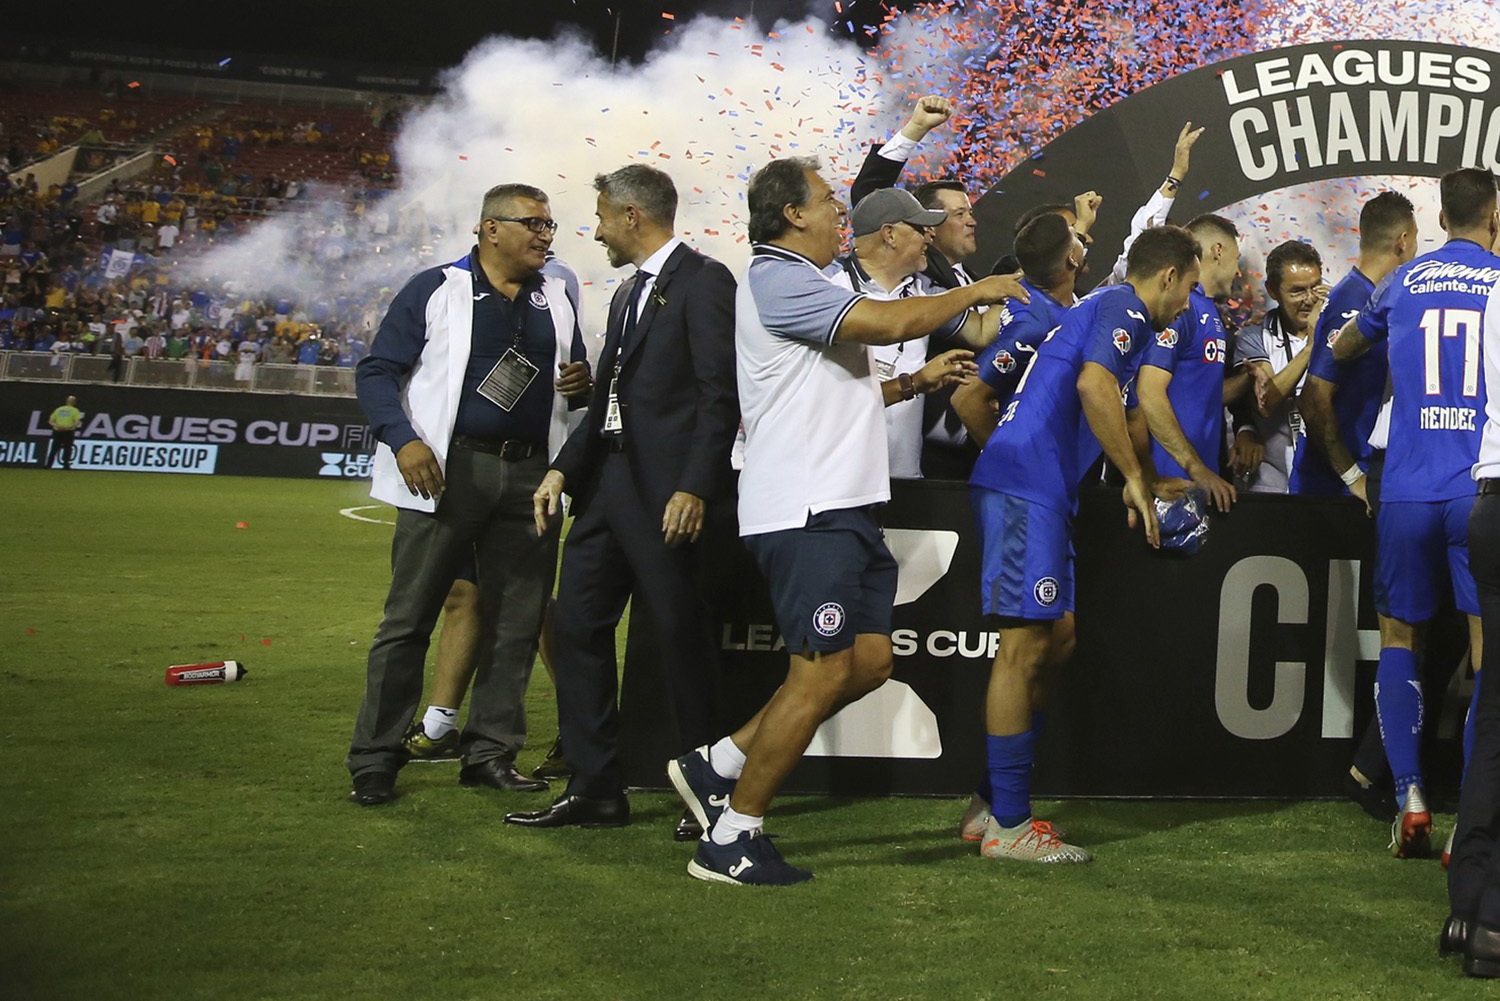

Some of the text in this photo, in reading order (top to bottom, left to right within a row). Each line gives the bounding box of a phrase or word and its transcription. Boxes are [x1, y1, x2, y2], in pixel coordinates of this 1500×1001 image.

[1222, 50, 1491, 104] LEAGUES
[1403, 260, 1500, 287] Caliente
[1419, 308, 1481, 397] 17
[27, 410, 237, 443] LAGUES
[245, 420, 339, 447] CUP
[1420, 407, 1476, 432] MENDEZ
[344, 466, 373, 478] CU
